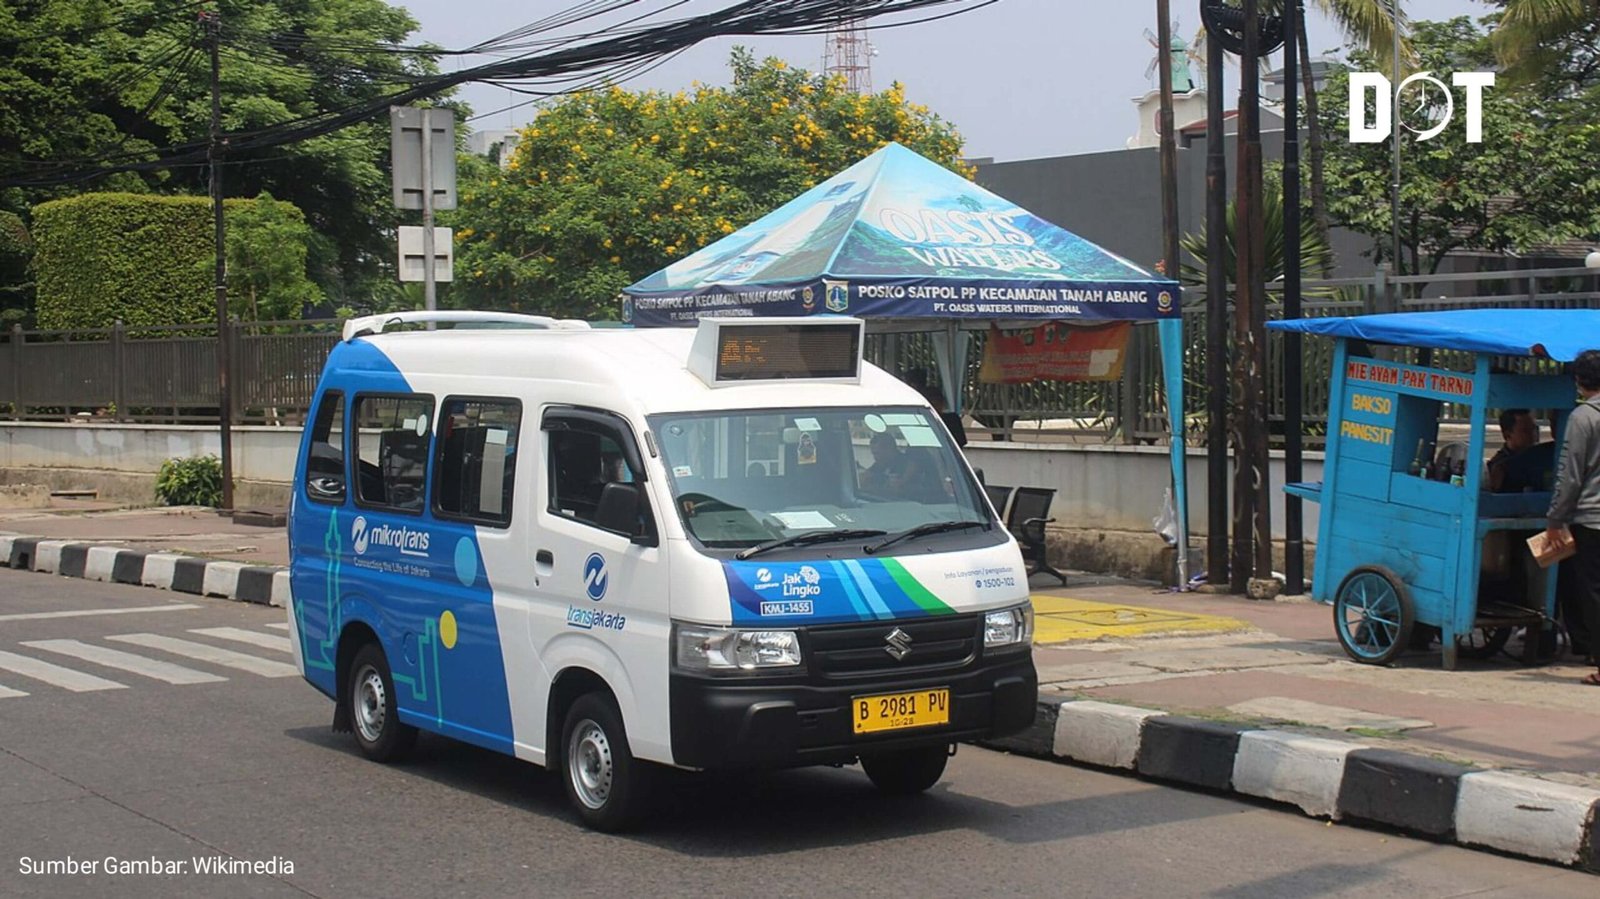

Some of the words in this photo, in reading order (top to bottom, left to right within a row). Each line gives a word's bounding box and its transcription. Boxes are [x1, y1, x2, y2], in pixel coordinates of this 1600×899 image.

[879, 207, 1035, 247] OASIS
[902, 247, 1062, 271] WATERS
[695, 292, 740, 306] KECAMATAN
[766, 288, 797, 302] ABANG
[858, 285, 905, 299] POSKO
[908, 286, 959, 300] SATPOL
[961, 287, 977, 301] PP
[979, 287, 1057, 302] KECAMATAN
[1060, 289, 1103, 302] TANAH
[1106, 290, 1148, 304] ABANG
[934, 303, 948, 313] PT.
[949, 304, 975, 313] OASIS
[976, 304, 1012, 314] WATERS
[1014, 305, 1081, 315] INTERNATIONAL
[1347, 362, 1368, 380] MIE
[1370, 365, 1399, 385] AYAM
[1402, 369, 1427, 389] PAK
[1430, 373, 1473, 396] TARNO
[1351, 394, 1392, 415] BAKSO
[1341, 420, 1393, 445] PANGSIT
[370, 524, 430, 557] mikrotrans
[782, 573, 801, 585] Jak
[783, 584, 820, 598] Lingko
[567, 604, 626, 630] transjakarta
[764, 603, 810, 614] KMJ-1455
[860, 701, 869, 720] B
[880, 696, 916, 718] 2981
[928, 692, 946, 712] PV
